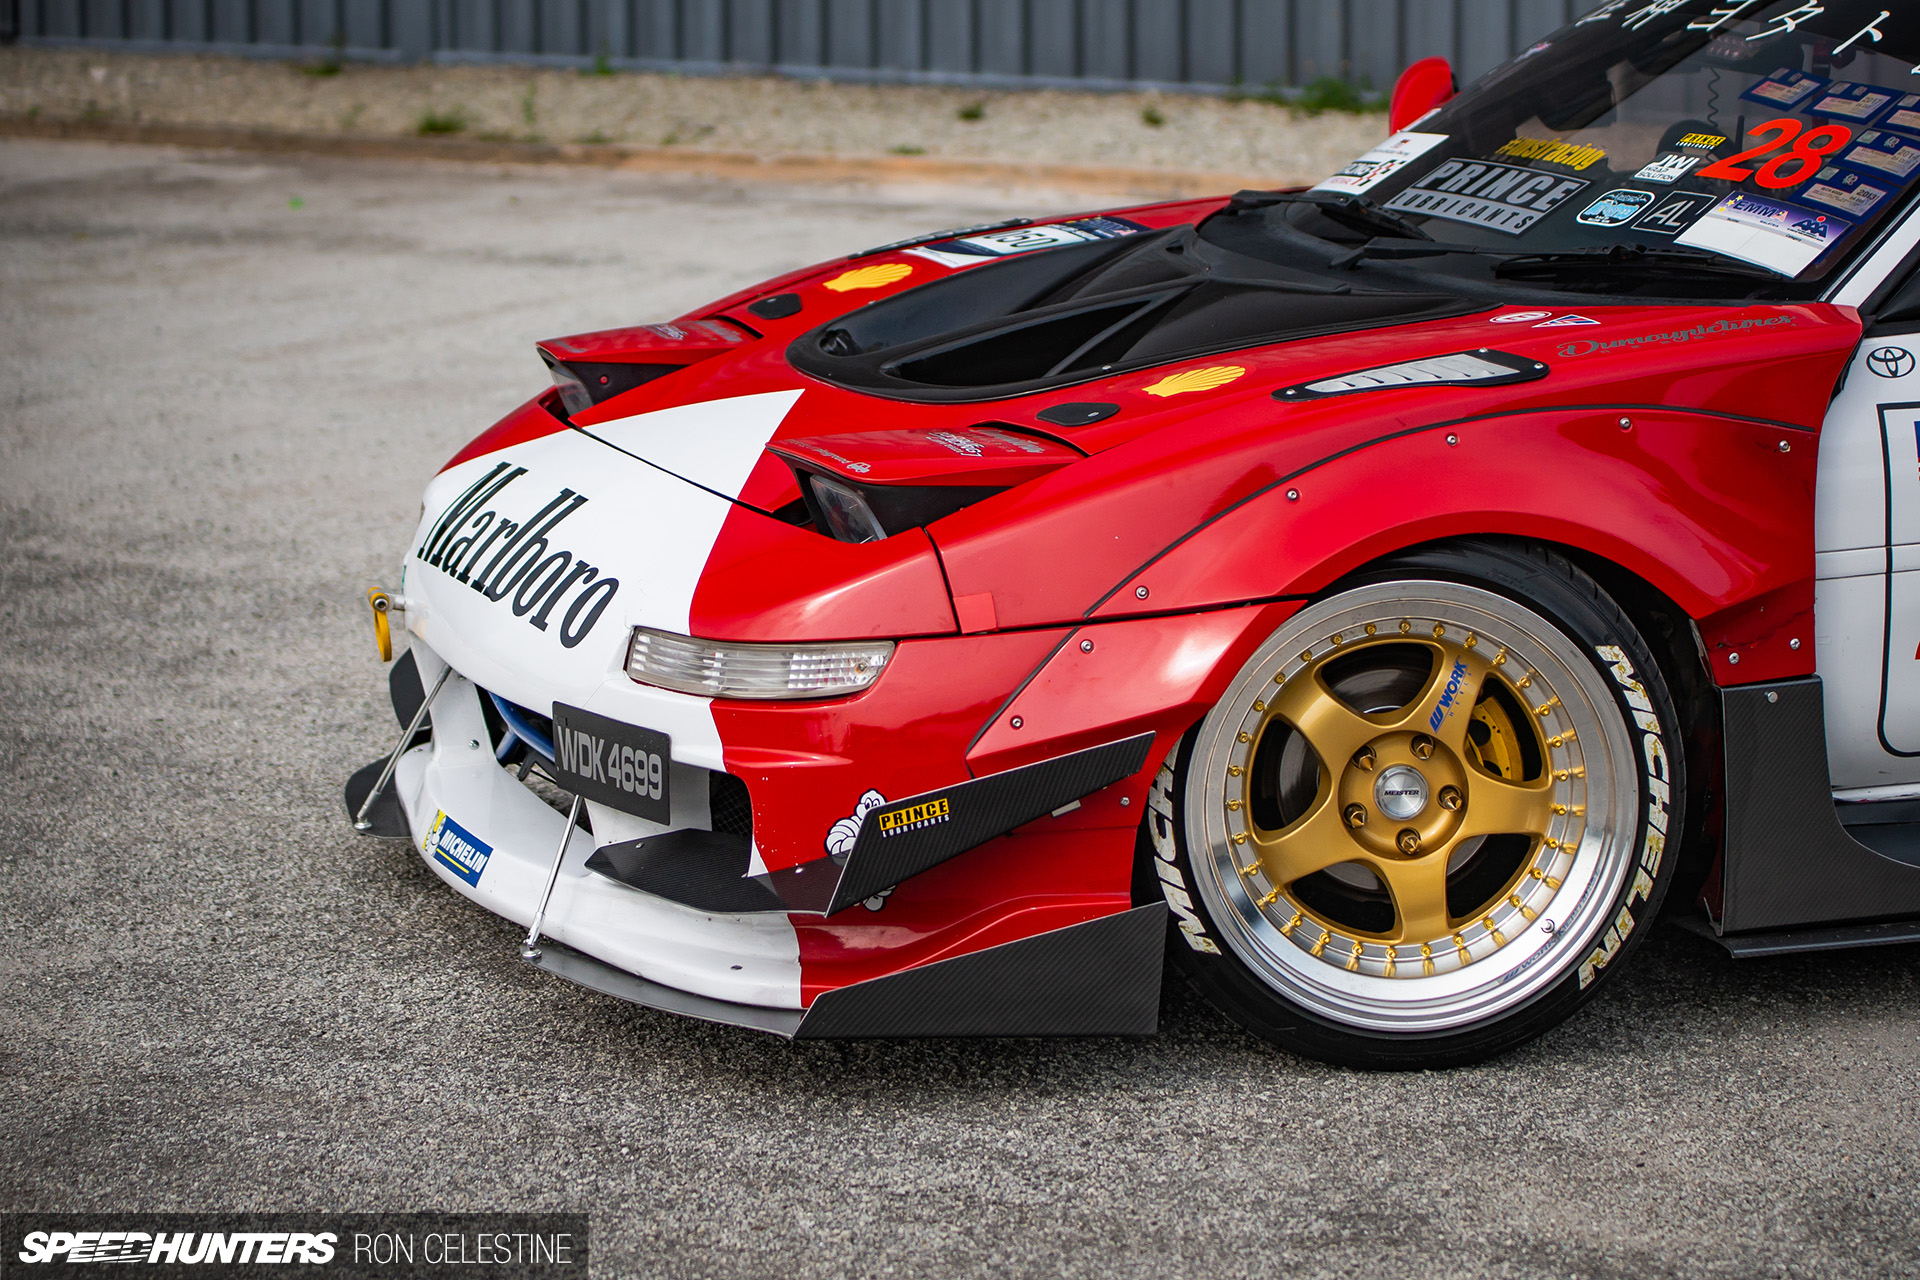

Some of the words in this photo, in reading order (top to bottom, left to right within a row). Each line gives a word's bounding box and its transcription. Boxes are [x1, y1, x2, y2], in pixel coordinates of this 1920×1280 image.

[1694, 118, 1851, 188] 28
[1413, 161, 1583, 213] PRINCE
[1638, 172, 1675, 181] SOLUTION
[1389, 191, 1535, 229] LUBRICANTS
[1733, 200, 1788, 222] EMMA
[416, 461, 620, 649] Marlboro
[1439, 660, 1467, 708] WORK
[557, 725, 607, 785] WDK
[607, 743, 662, 801] 4699
[881, 798, 948, 829] PRINCE
[882, 813, 950, 839] LUBRICANTS
[1579, 645, 1670, 990] MICHELIN
[440, 829, 488, 874] MICHELIN
